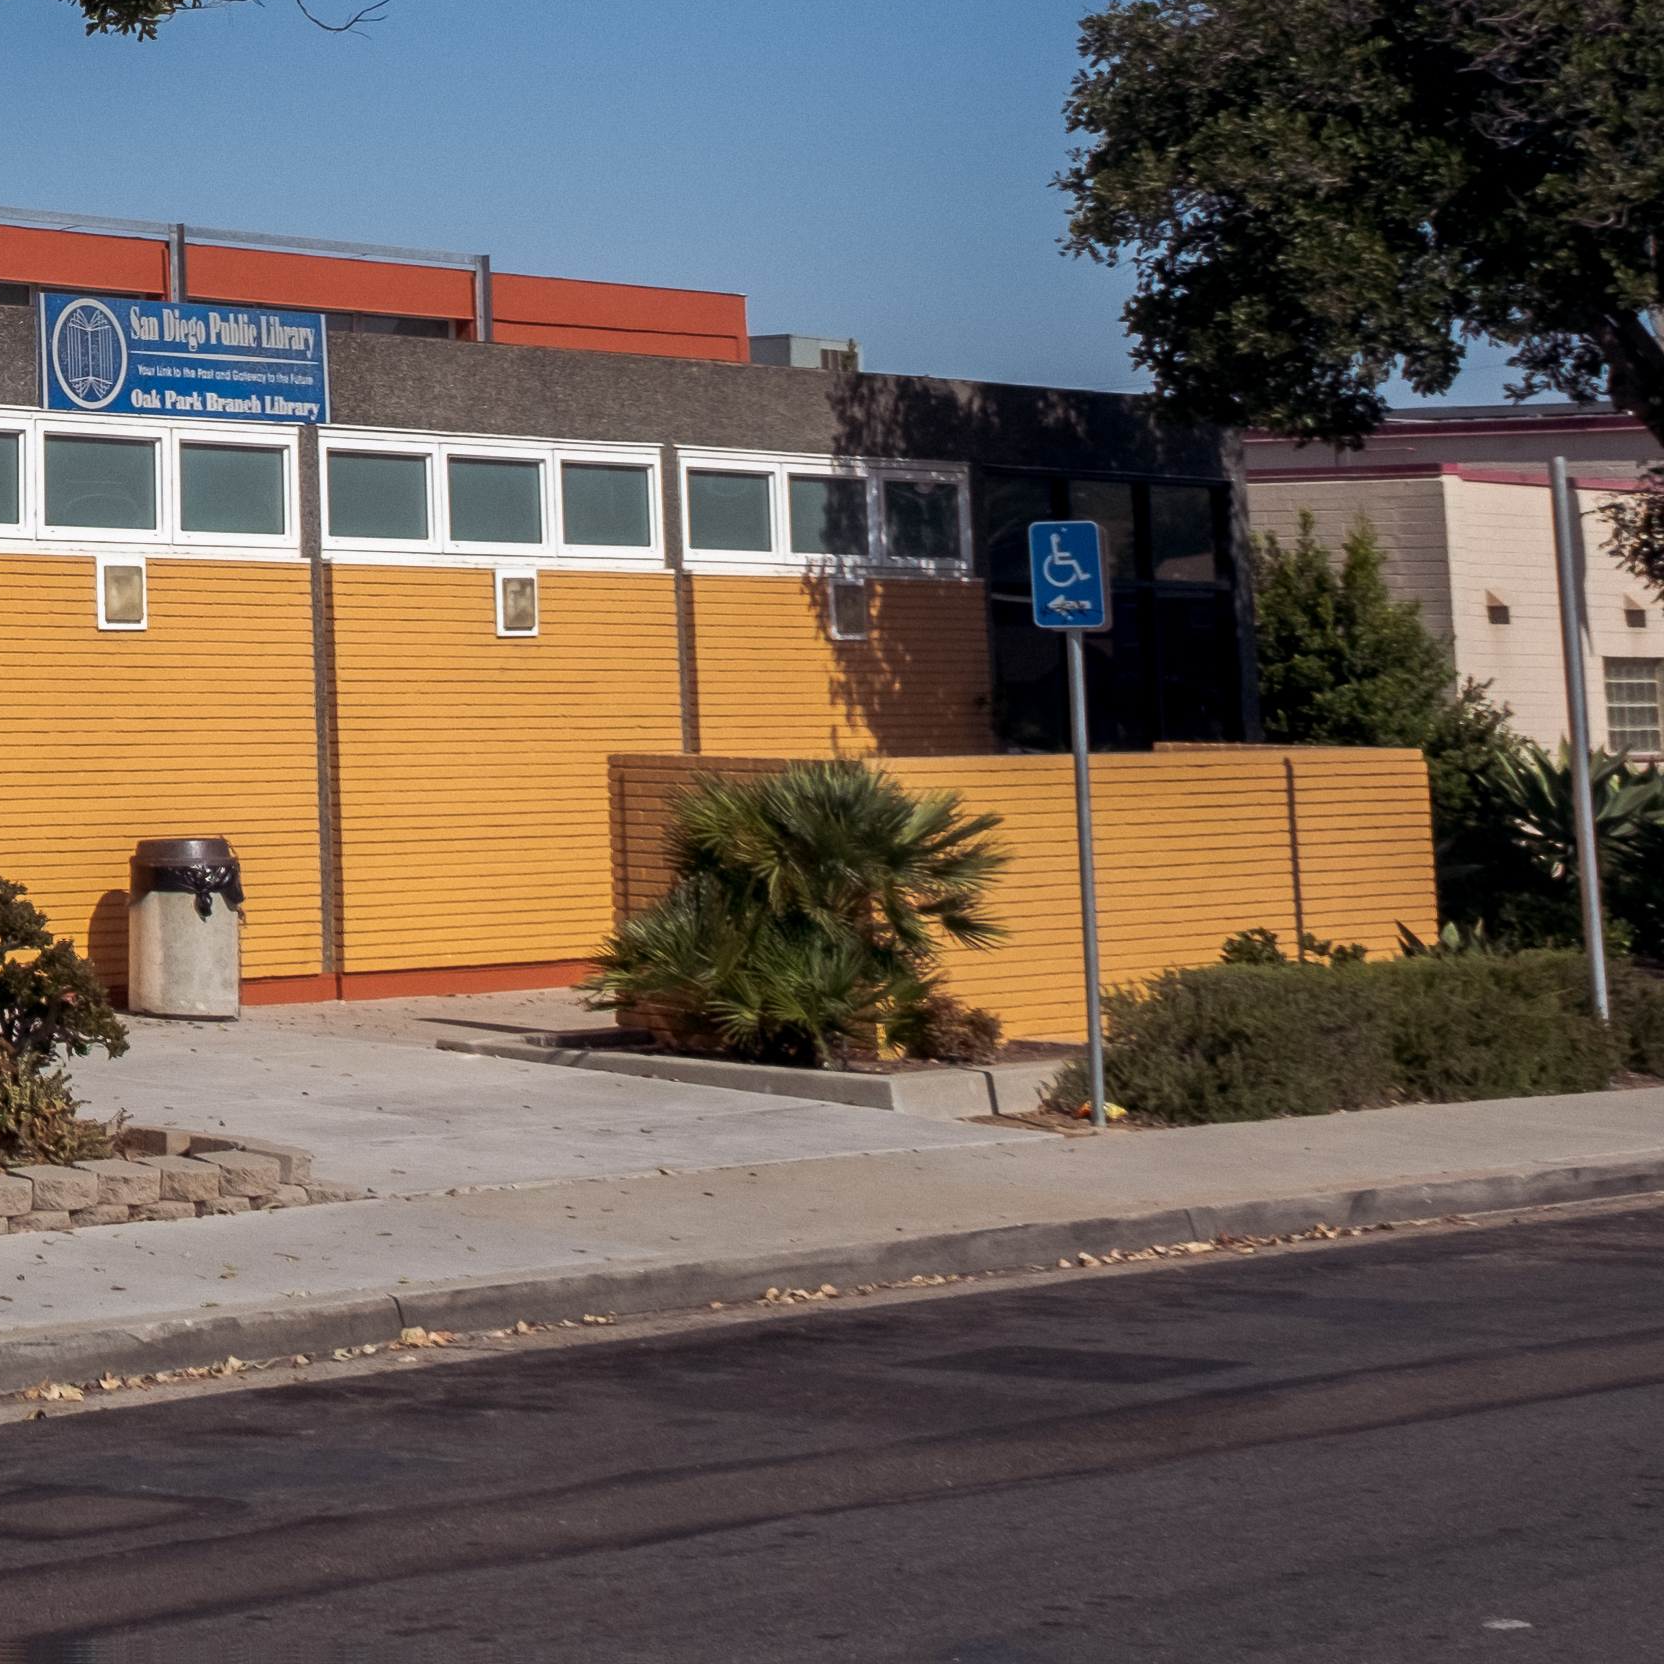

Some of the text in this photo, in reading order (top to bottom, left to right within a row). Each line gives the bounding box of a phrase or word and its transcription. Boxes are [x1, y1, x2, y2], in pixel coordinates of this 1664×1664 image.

[129, 306, 316, 359] San Diego Public Library
[137, 364, 314, 386] Your Link to the Past and Gateway to the Future
[130, 388, 321, 421] Oak Park Branch Library
